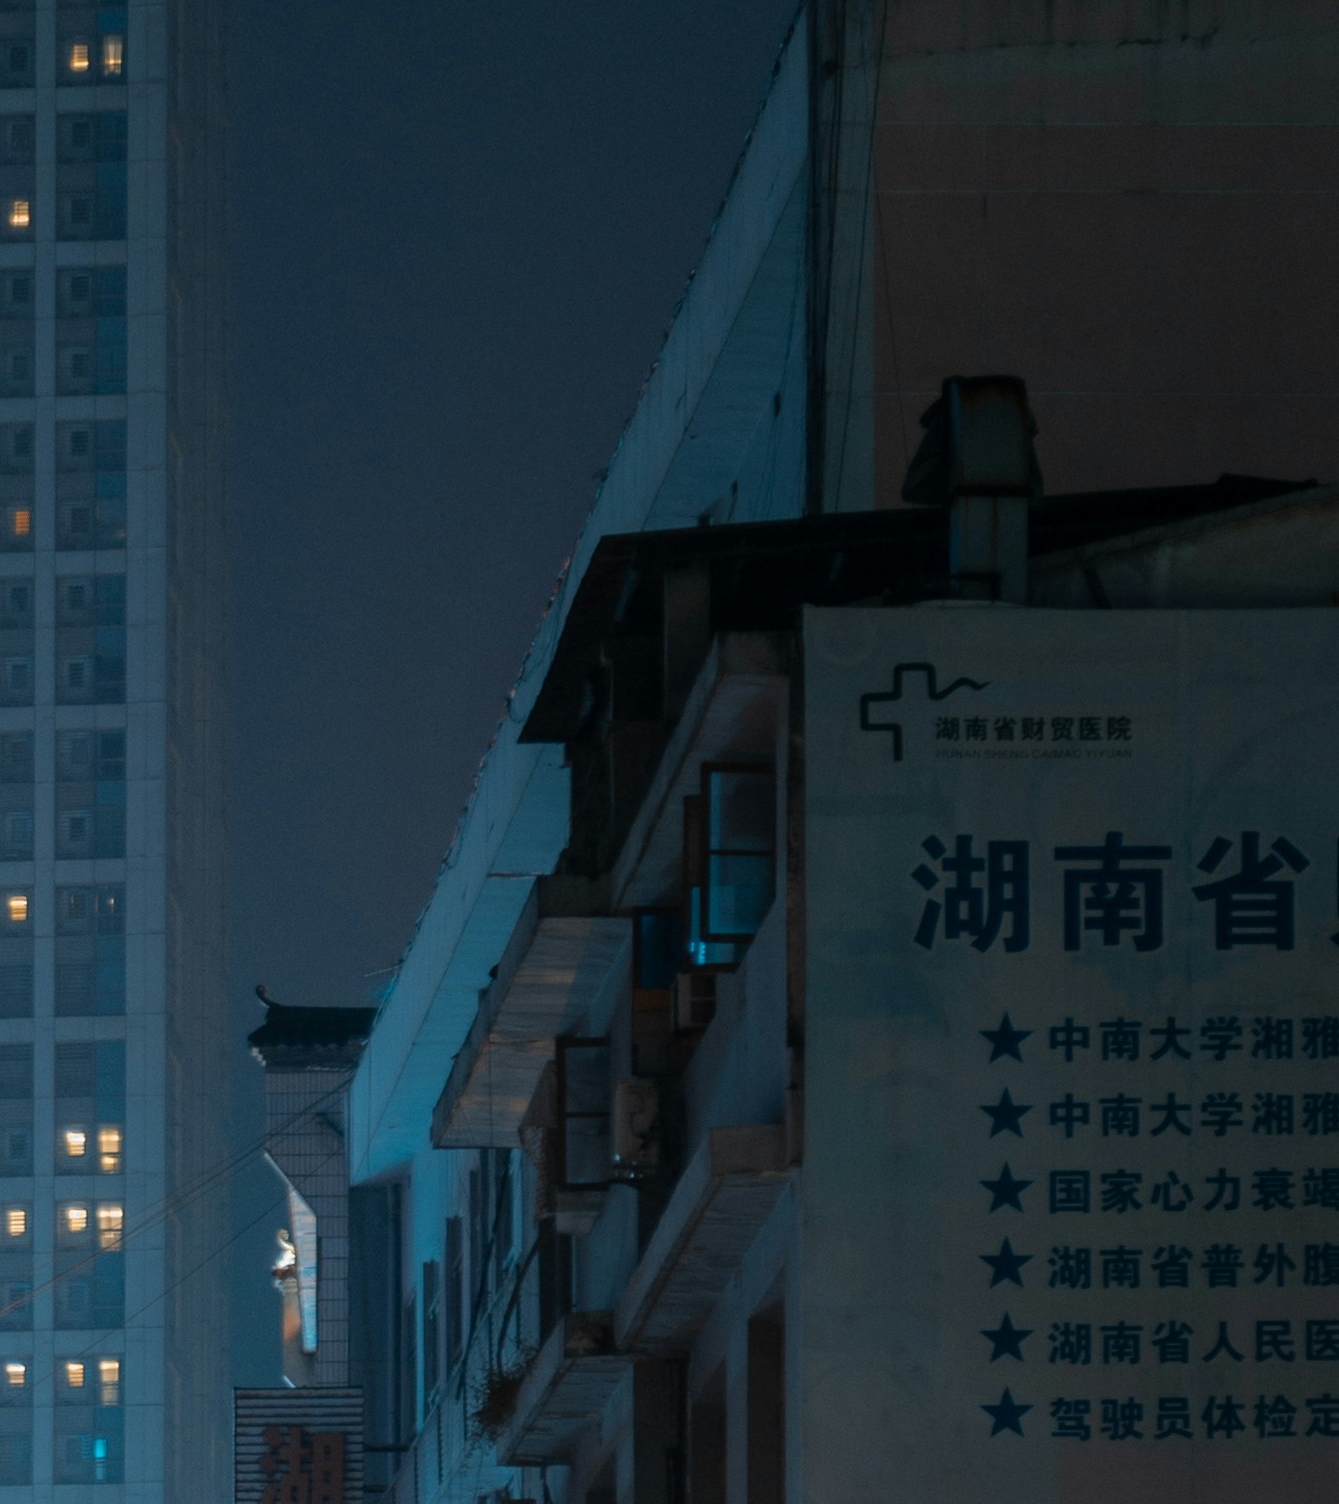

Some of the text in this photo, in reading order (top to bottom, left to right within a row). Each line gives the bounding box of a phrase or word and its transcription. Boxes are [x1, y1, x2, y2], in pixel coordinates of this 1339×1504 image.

[935, 715, 1133, 742] 湖南省财贸医院
[936, 749, 984, 760] HUNAN
[985, 749, 1028, 760] SHENG
[911, 831, 1339, 953] 湖南省
